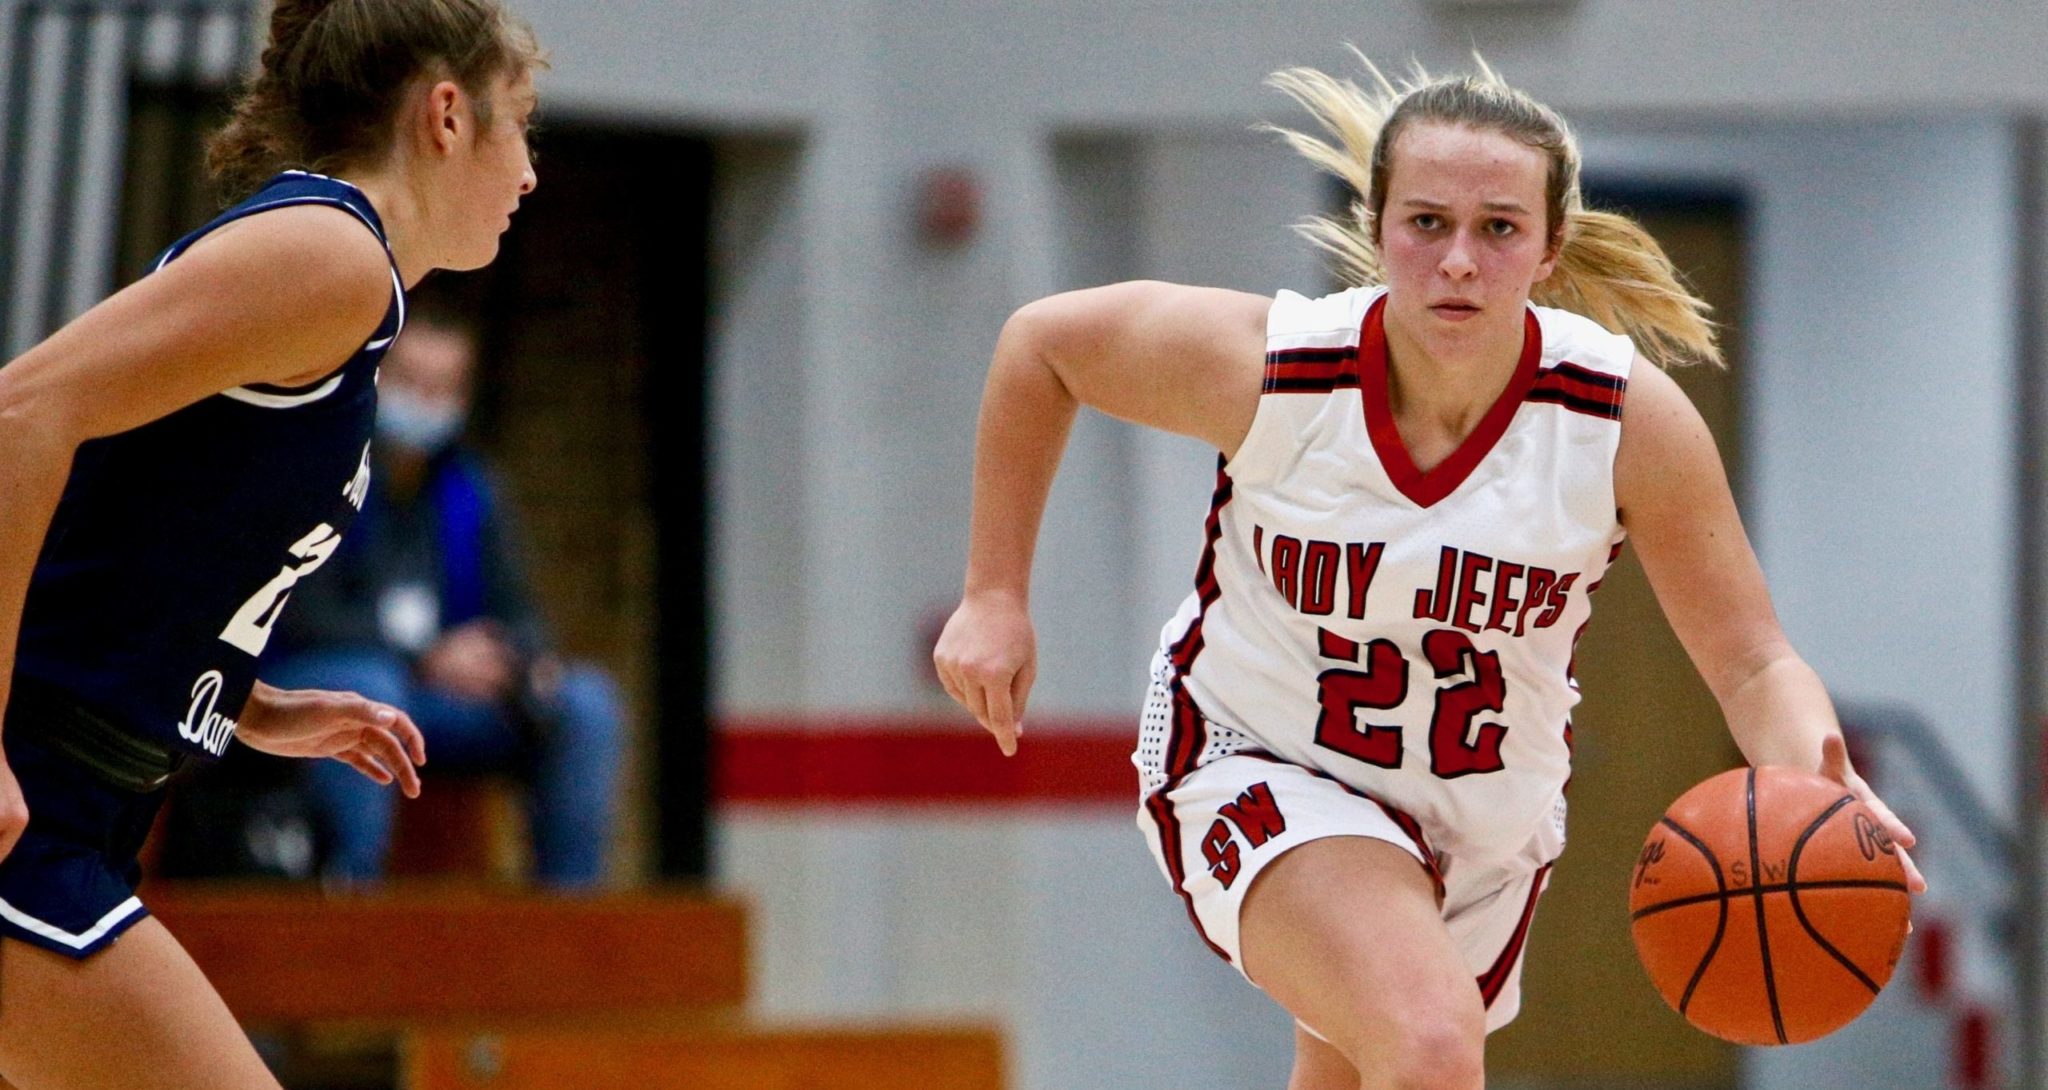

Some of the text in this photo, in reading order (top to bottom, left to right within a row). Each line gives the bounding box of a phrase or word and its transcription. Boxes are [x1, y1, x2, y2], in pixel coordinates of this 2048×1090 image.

[1253, 524, 1581, 637] LADY JEEPS
[1313, 626, 1509, 780] 22
[1201, 781, 1286, 891] SW
